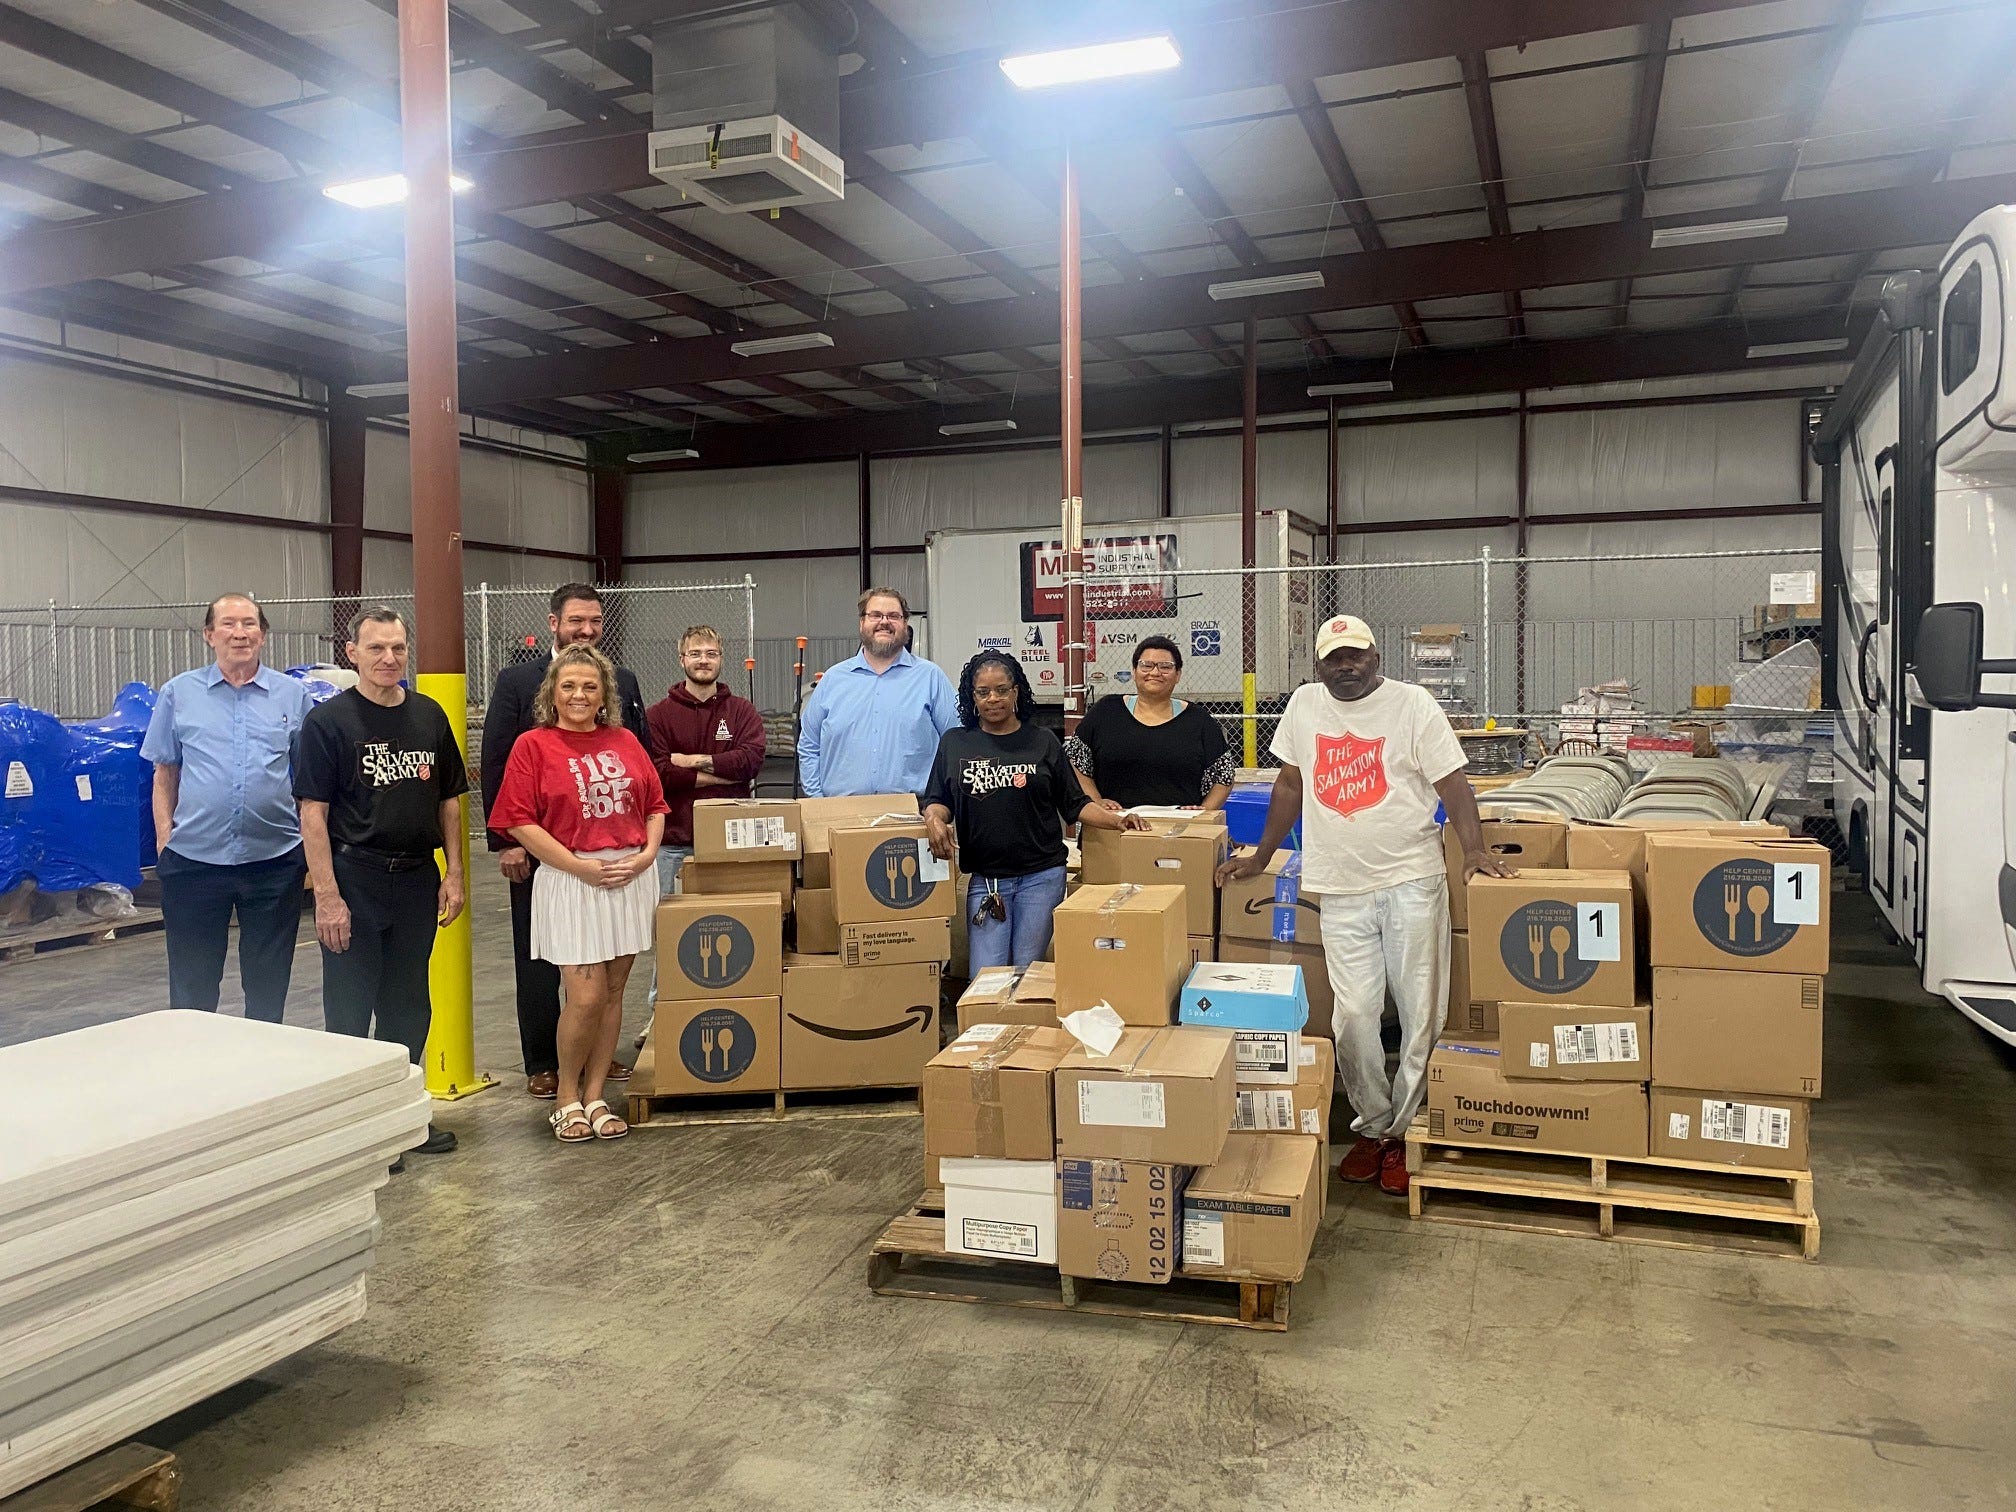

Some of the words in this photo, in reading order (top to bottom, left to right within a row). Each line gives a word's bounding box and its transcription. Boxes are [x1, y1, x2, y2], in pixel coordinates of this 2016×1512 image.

[1040, 554, 1096, 576] MS
[1098, 553, 1155, 563] INDUSTRIAL
[1098, 563, 1136, 573] SUPPLY
[1190, 620, 1220, 630] BRADY
[977, 637, 1012, 648] MARKAL
[364, 743, 391, 756] THE
[1326, 742, 1353, 765] THE
[362, 750, 435, 775] SALVATION
[581, 750, 626, 782] 18
[968, 759, 991, 769] THE
[1317, 746, 1377, 794] SALVATION
[373, 763, 420, 787] ARMY
[962, 764, 1037, 784] SALVATION
[970, 773, 1014, 795] ARMY
[1335, 769, 1377, 806] ARMY
[1788, 871, 1802, 900] 1
[1589, 910, 1603, 937] 1
[863, 950, 881, 958] prime
[1268, 1033, 1286, 1041] PAPER
[1454, 1095, 1589, 1121] Touchdoowwnn!
[1454, 1116, 1484, 1127] prime
[1149, 1166, 1166, 1191] 02
[1149, 1197, 1166, 1220] 15
[1197, 1200, 1223, 1209] EXAM
[1225, 1202, 1253, 1212] TABLE
[1254, 1205, 1284, 1215] PAPER
[966, 1220, 998, 1229] Multipurpose
[1149, 1226, 1166, 1250] 02
[1149, 1256, 1166, 1279] 12
